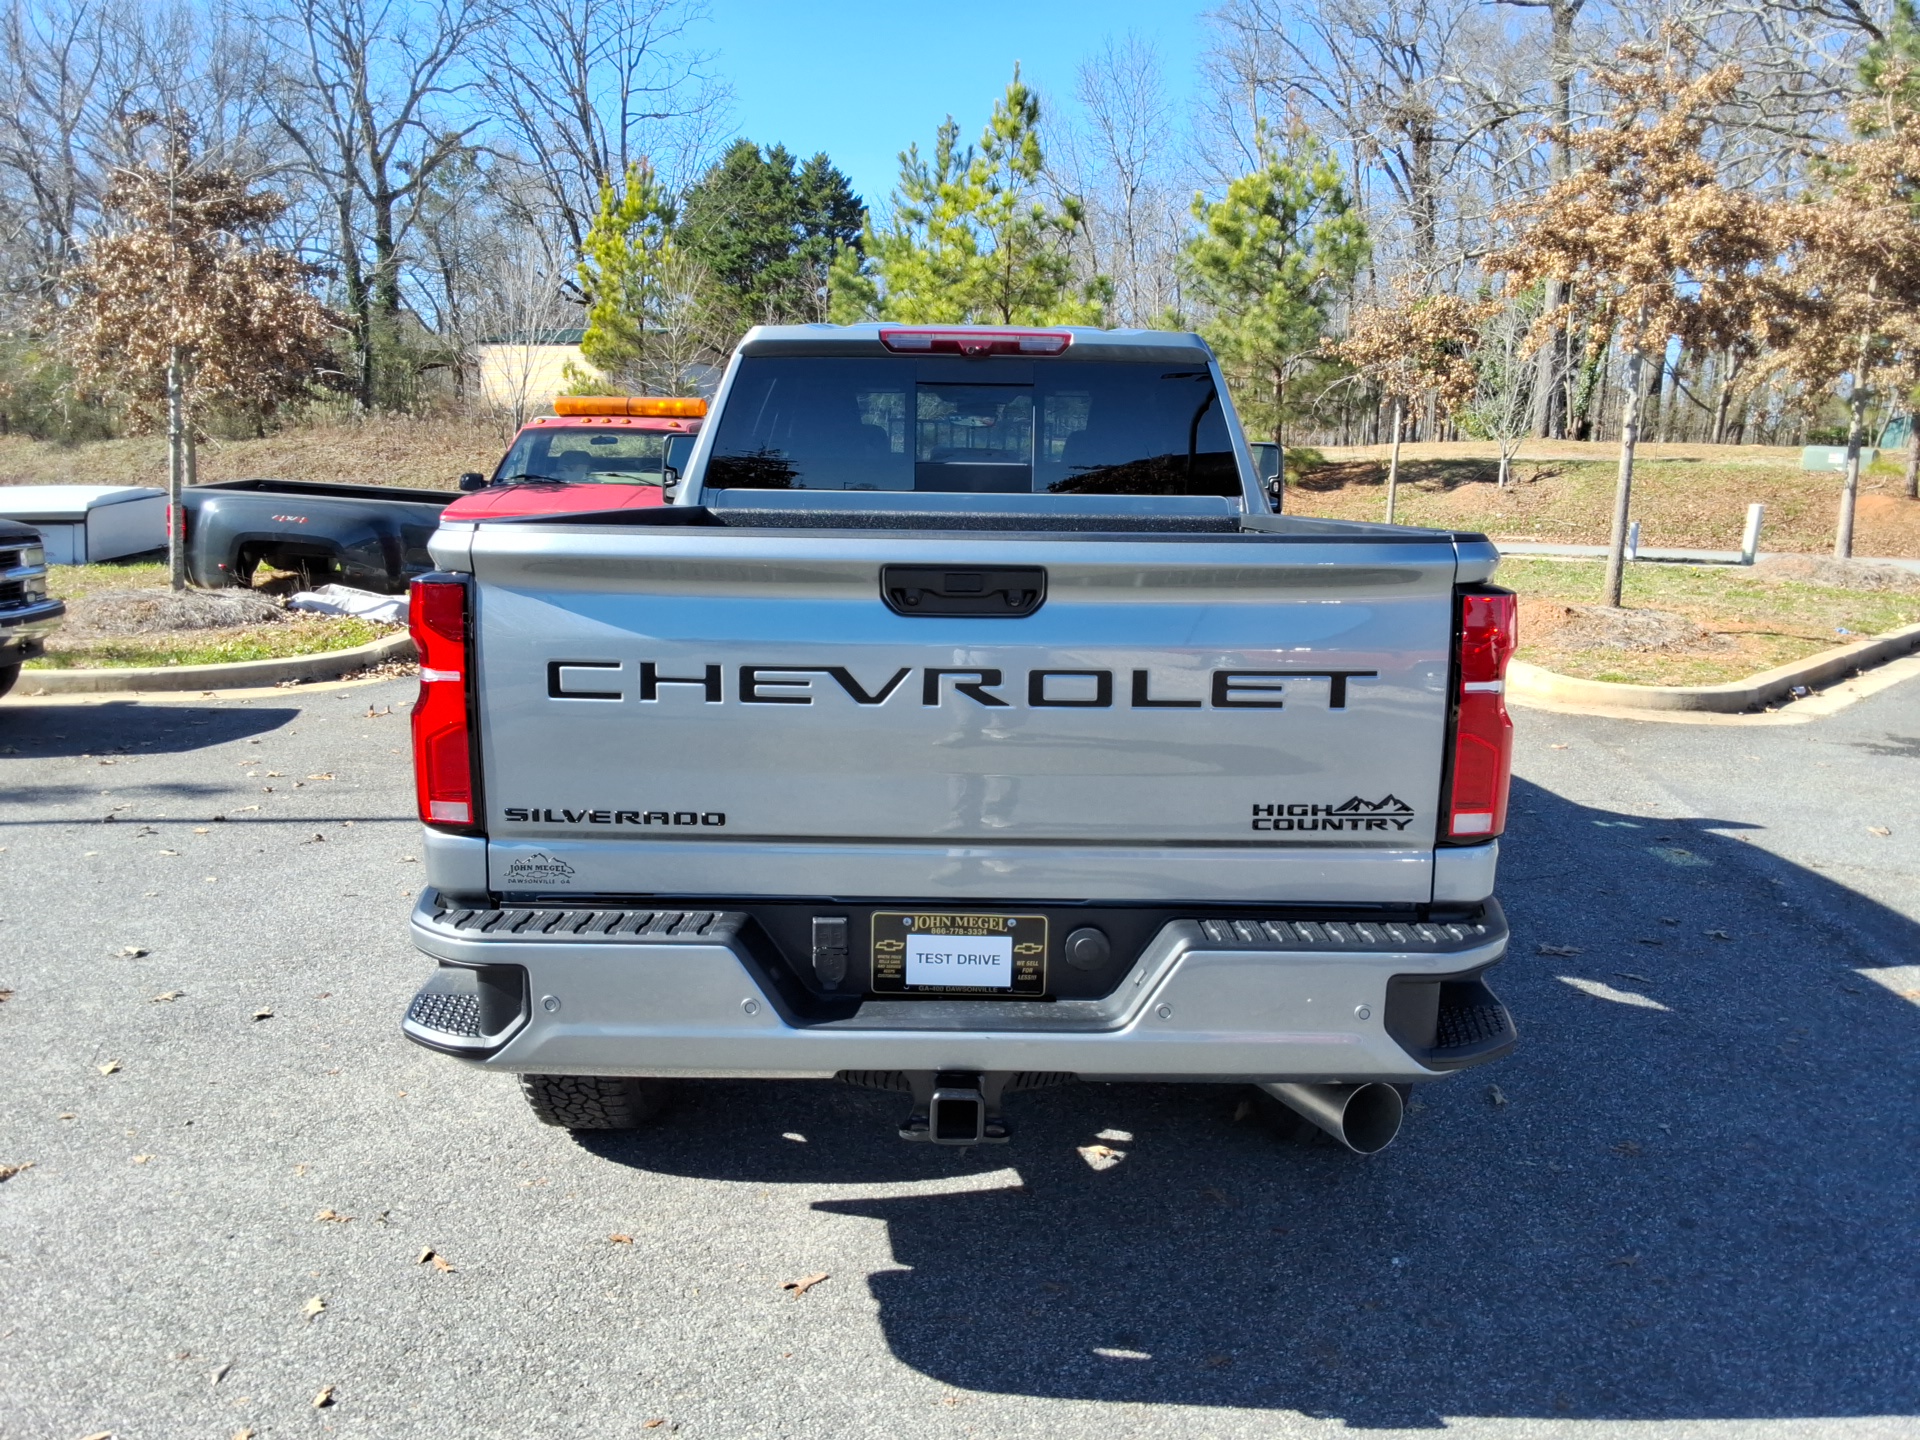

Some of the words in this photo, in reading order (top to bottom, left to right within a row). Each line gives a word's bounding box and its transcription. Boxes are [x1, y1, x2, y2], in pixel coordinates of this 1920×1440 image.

[547, 661, 1378, 708] CHEVROLET
[504, 807, 726, 826] SILVERADO
[1252, 804, 1333, 816] HIGH
[1252, 818, 1414, 831] COUNTRY
[510, 864, 533, 873] JOHN
[535, 864, 566, 872] MEGEL
[911, 915, 952, 932] JOHN
[955, 916, 1008, 932] MEGEL
[931, 927, 987, 935] 866-778-3334
[916, 952, 952, 965] TEST
[957, 953, 1001, 966] DRIVE
